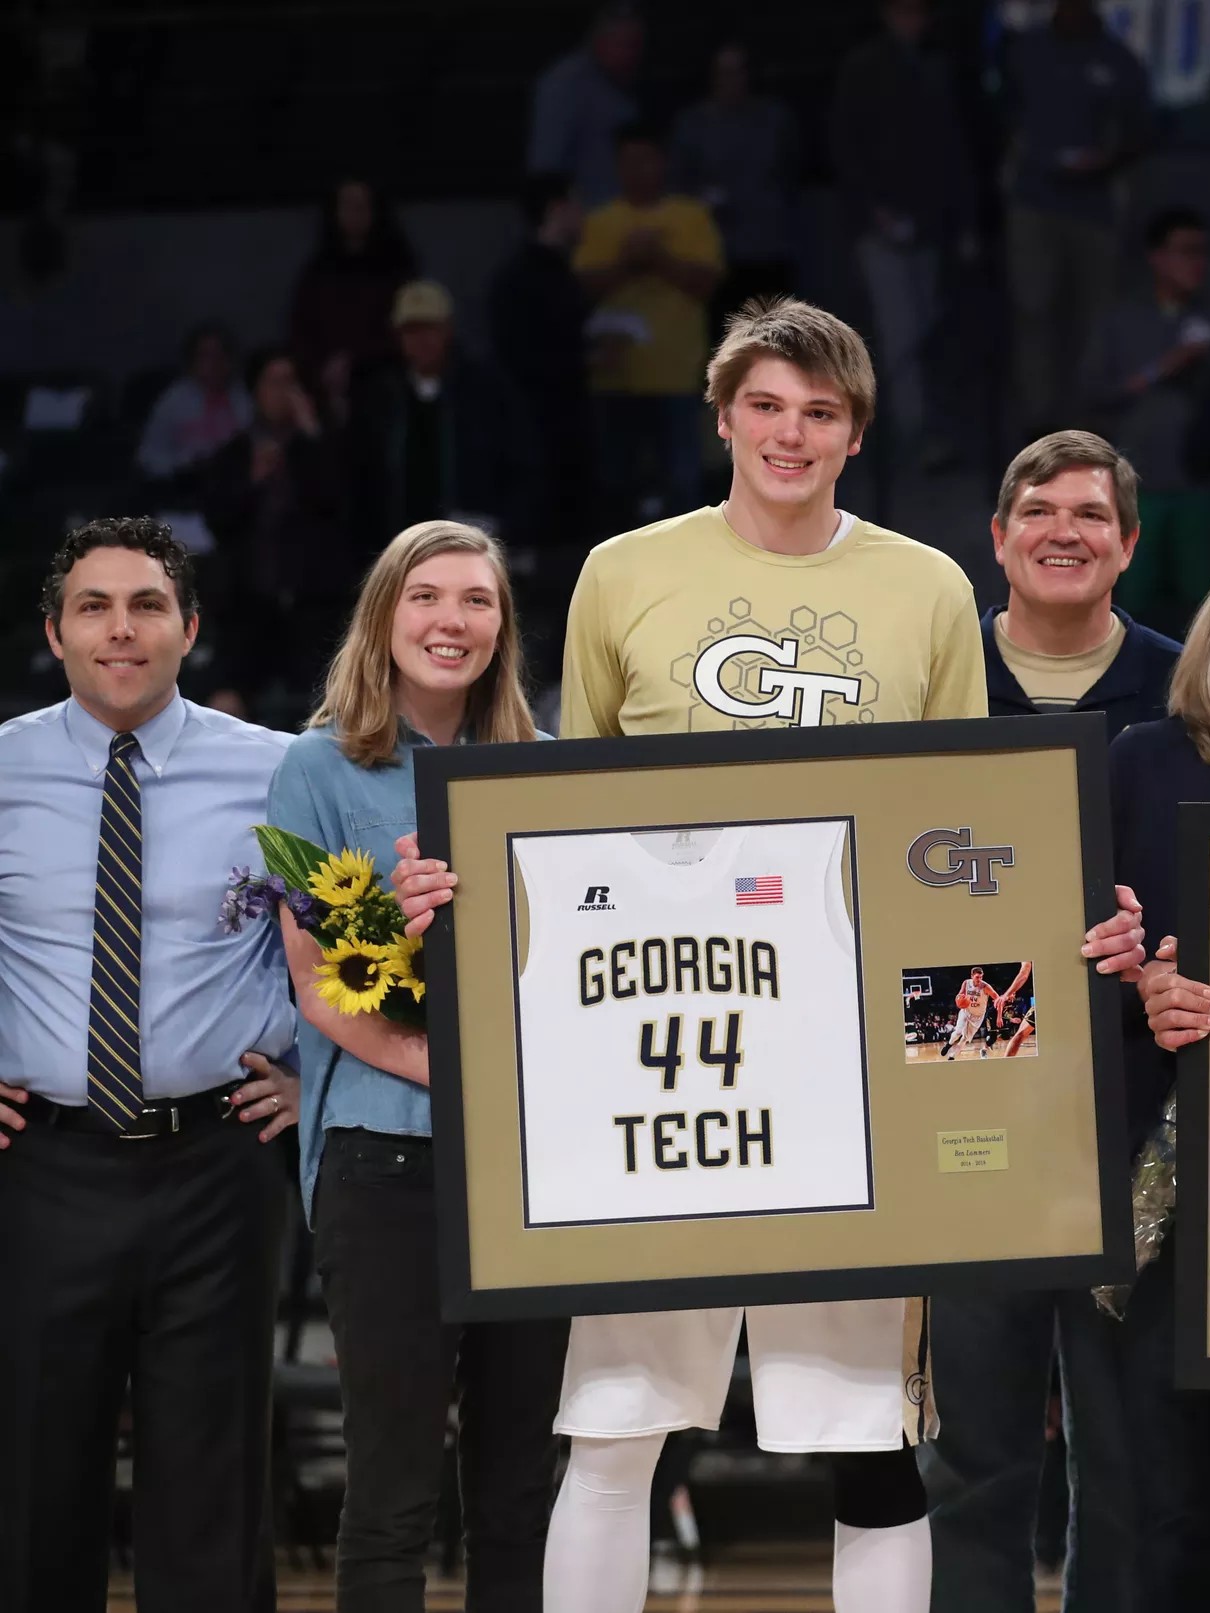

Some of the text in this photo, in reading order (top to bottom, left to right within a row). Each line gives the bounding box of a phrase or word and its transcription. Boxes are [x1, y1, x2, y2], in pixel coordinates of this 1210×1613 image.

[693, 634, 861, 728] GT
[906, 827, 1015, 894] GT
[579, 935, 781, 1008] GEORGIA
[638, 1010, 744, 1093] 44
[612, 1107, 774, 1174] TECH
[942, 1137, 962, 1145] Georgia
[976, 1135, 1004, 1143] Basketball
